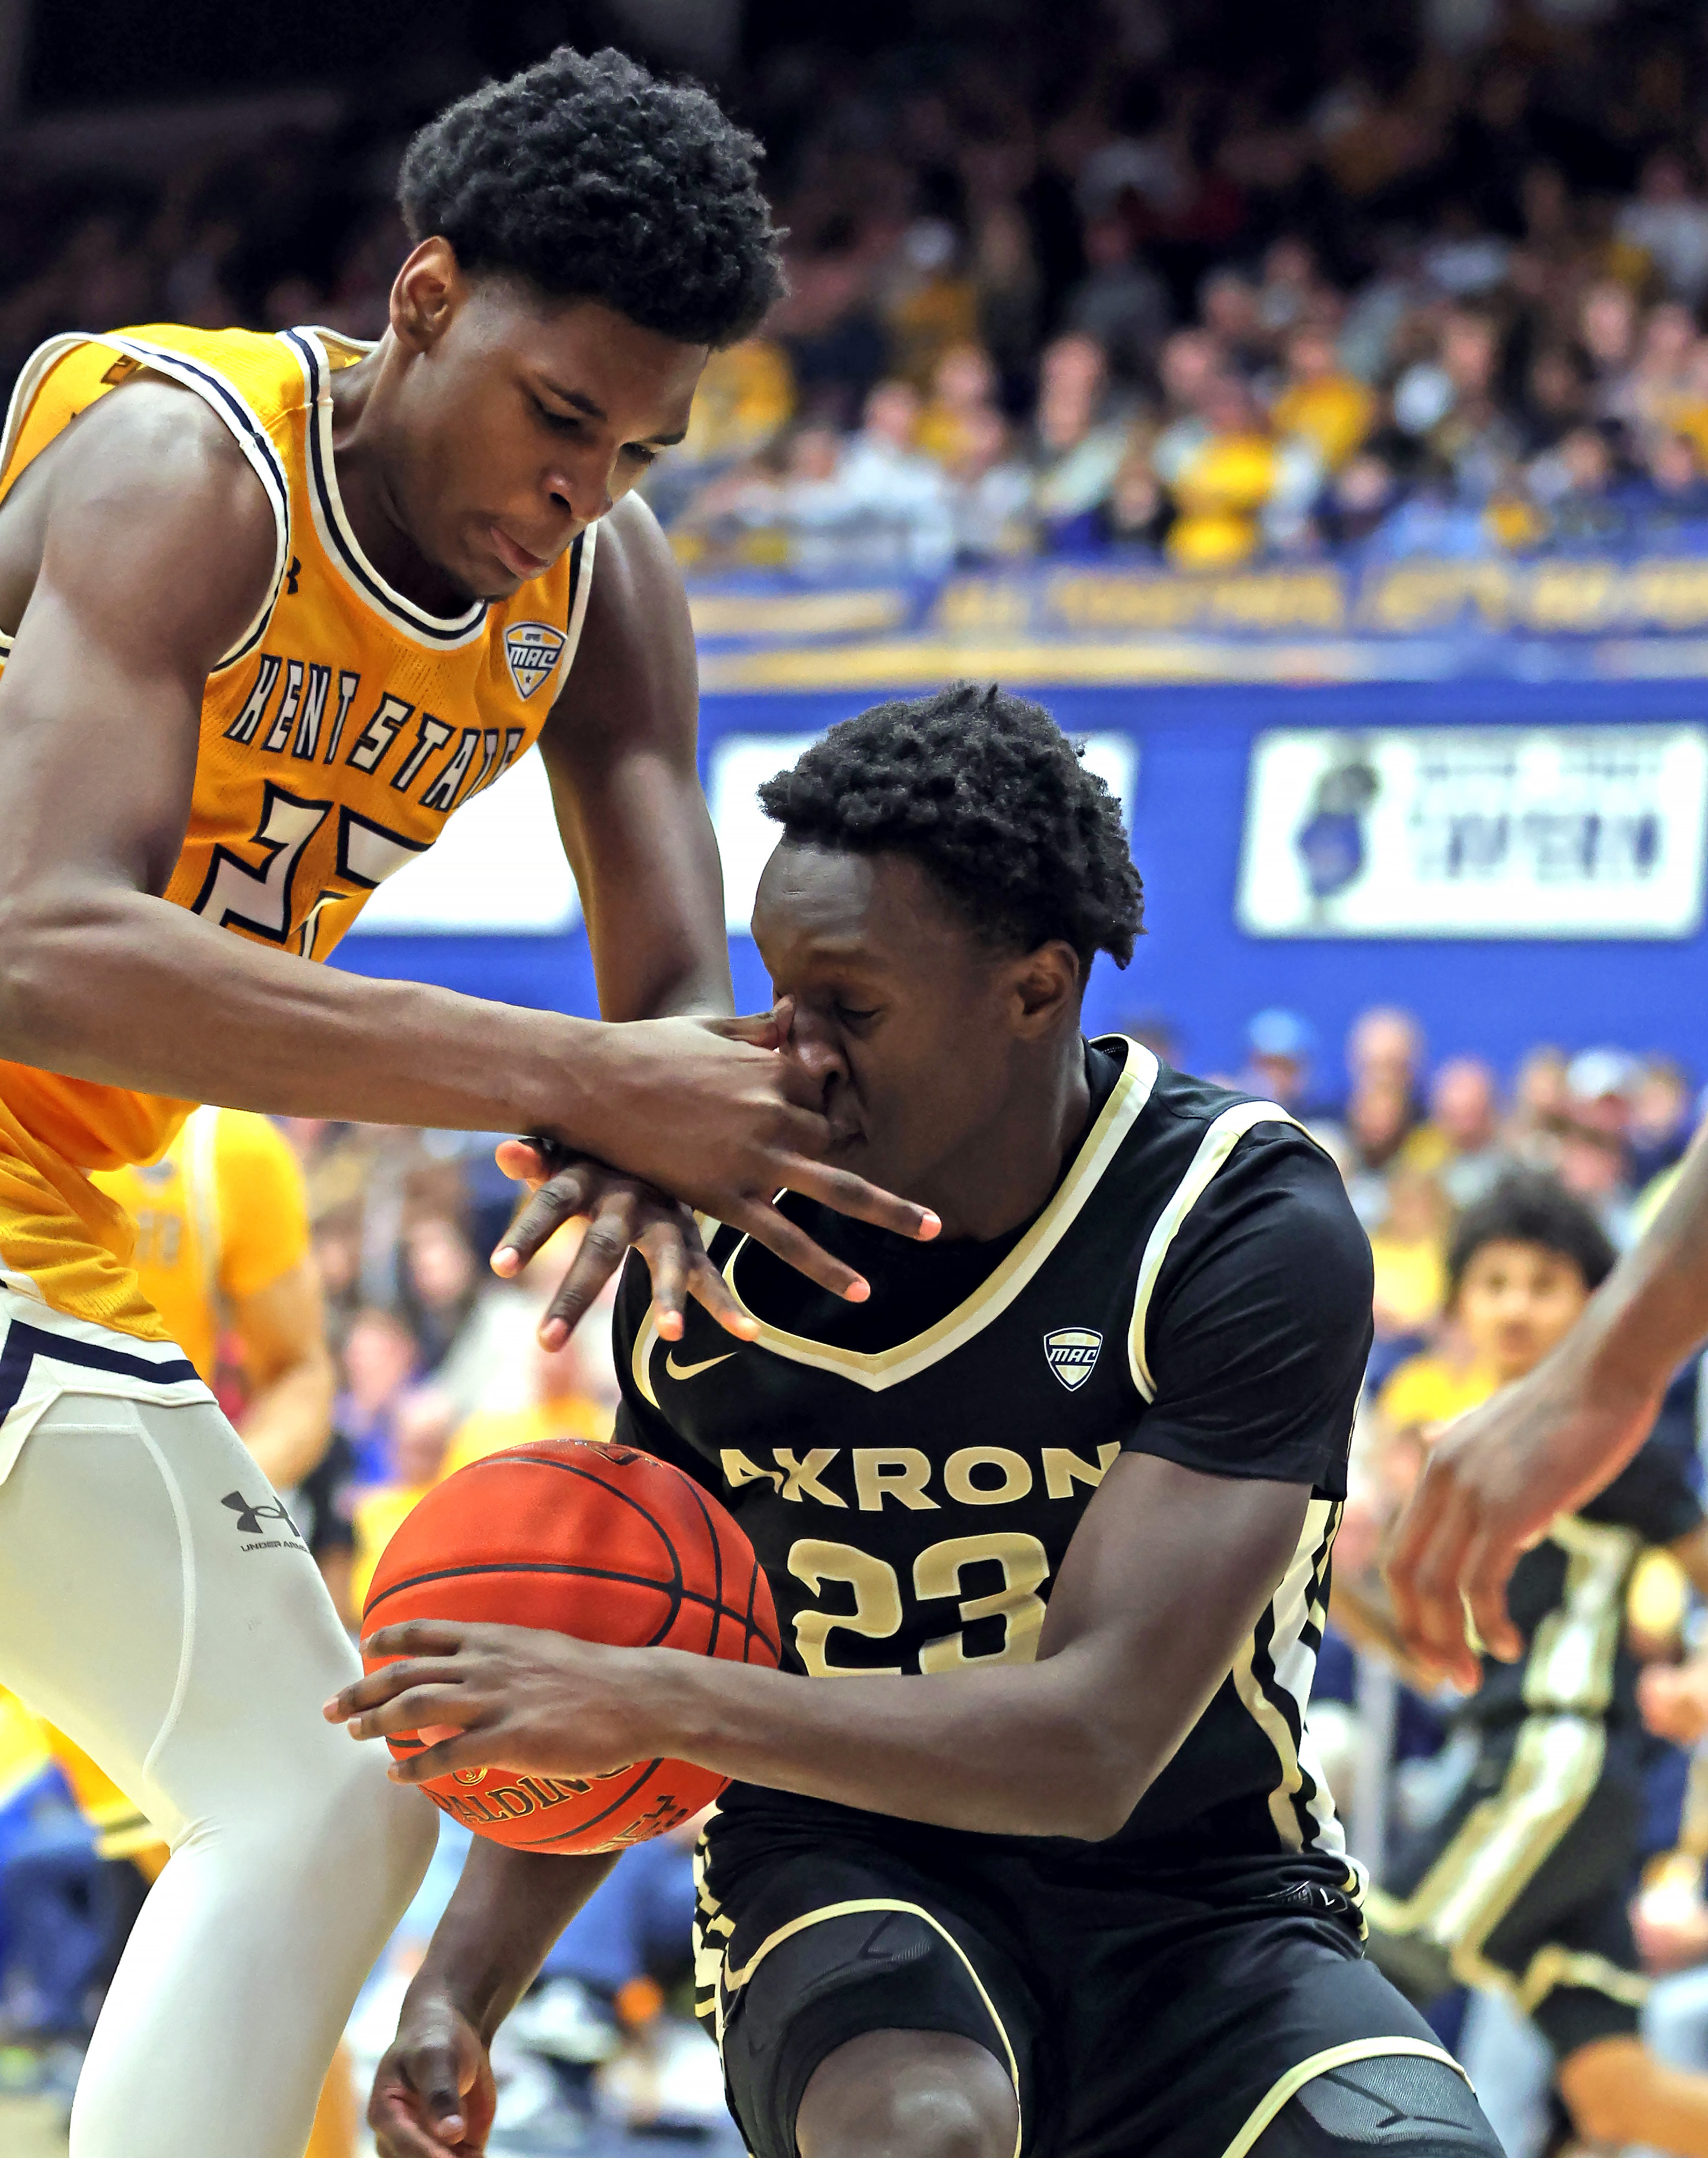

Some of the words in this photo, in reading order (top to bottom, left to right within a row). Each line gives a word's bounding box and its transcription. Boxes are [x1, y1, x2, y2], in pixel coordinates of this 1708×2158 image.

[510, 646, 558, 669] MAC
[222, 653, 361, 765] KENT
[1048, 1347, 1098, 1363] MAC
[720, 1440, 1121, 1511] AKRON
[240, 1541, 282, 1552] UNDER
[787, 1532, 1050, 1678] 23
